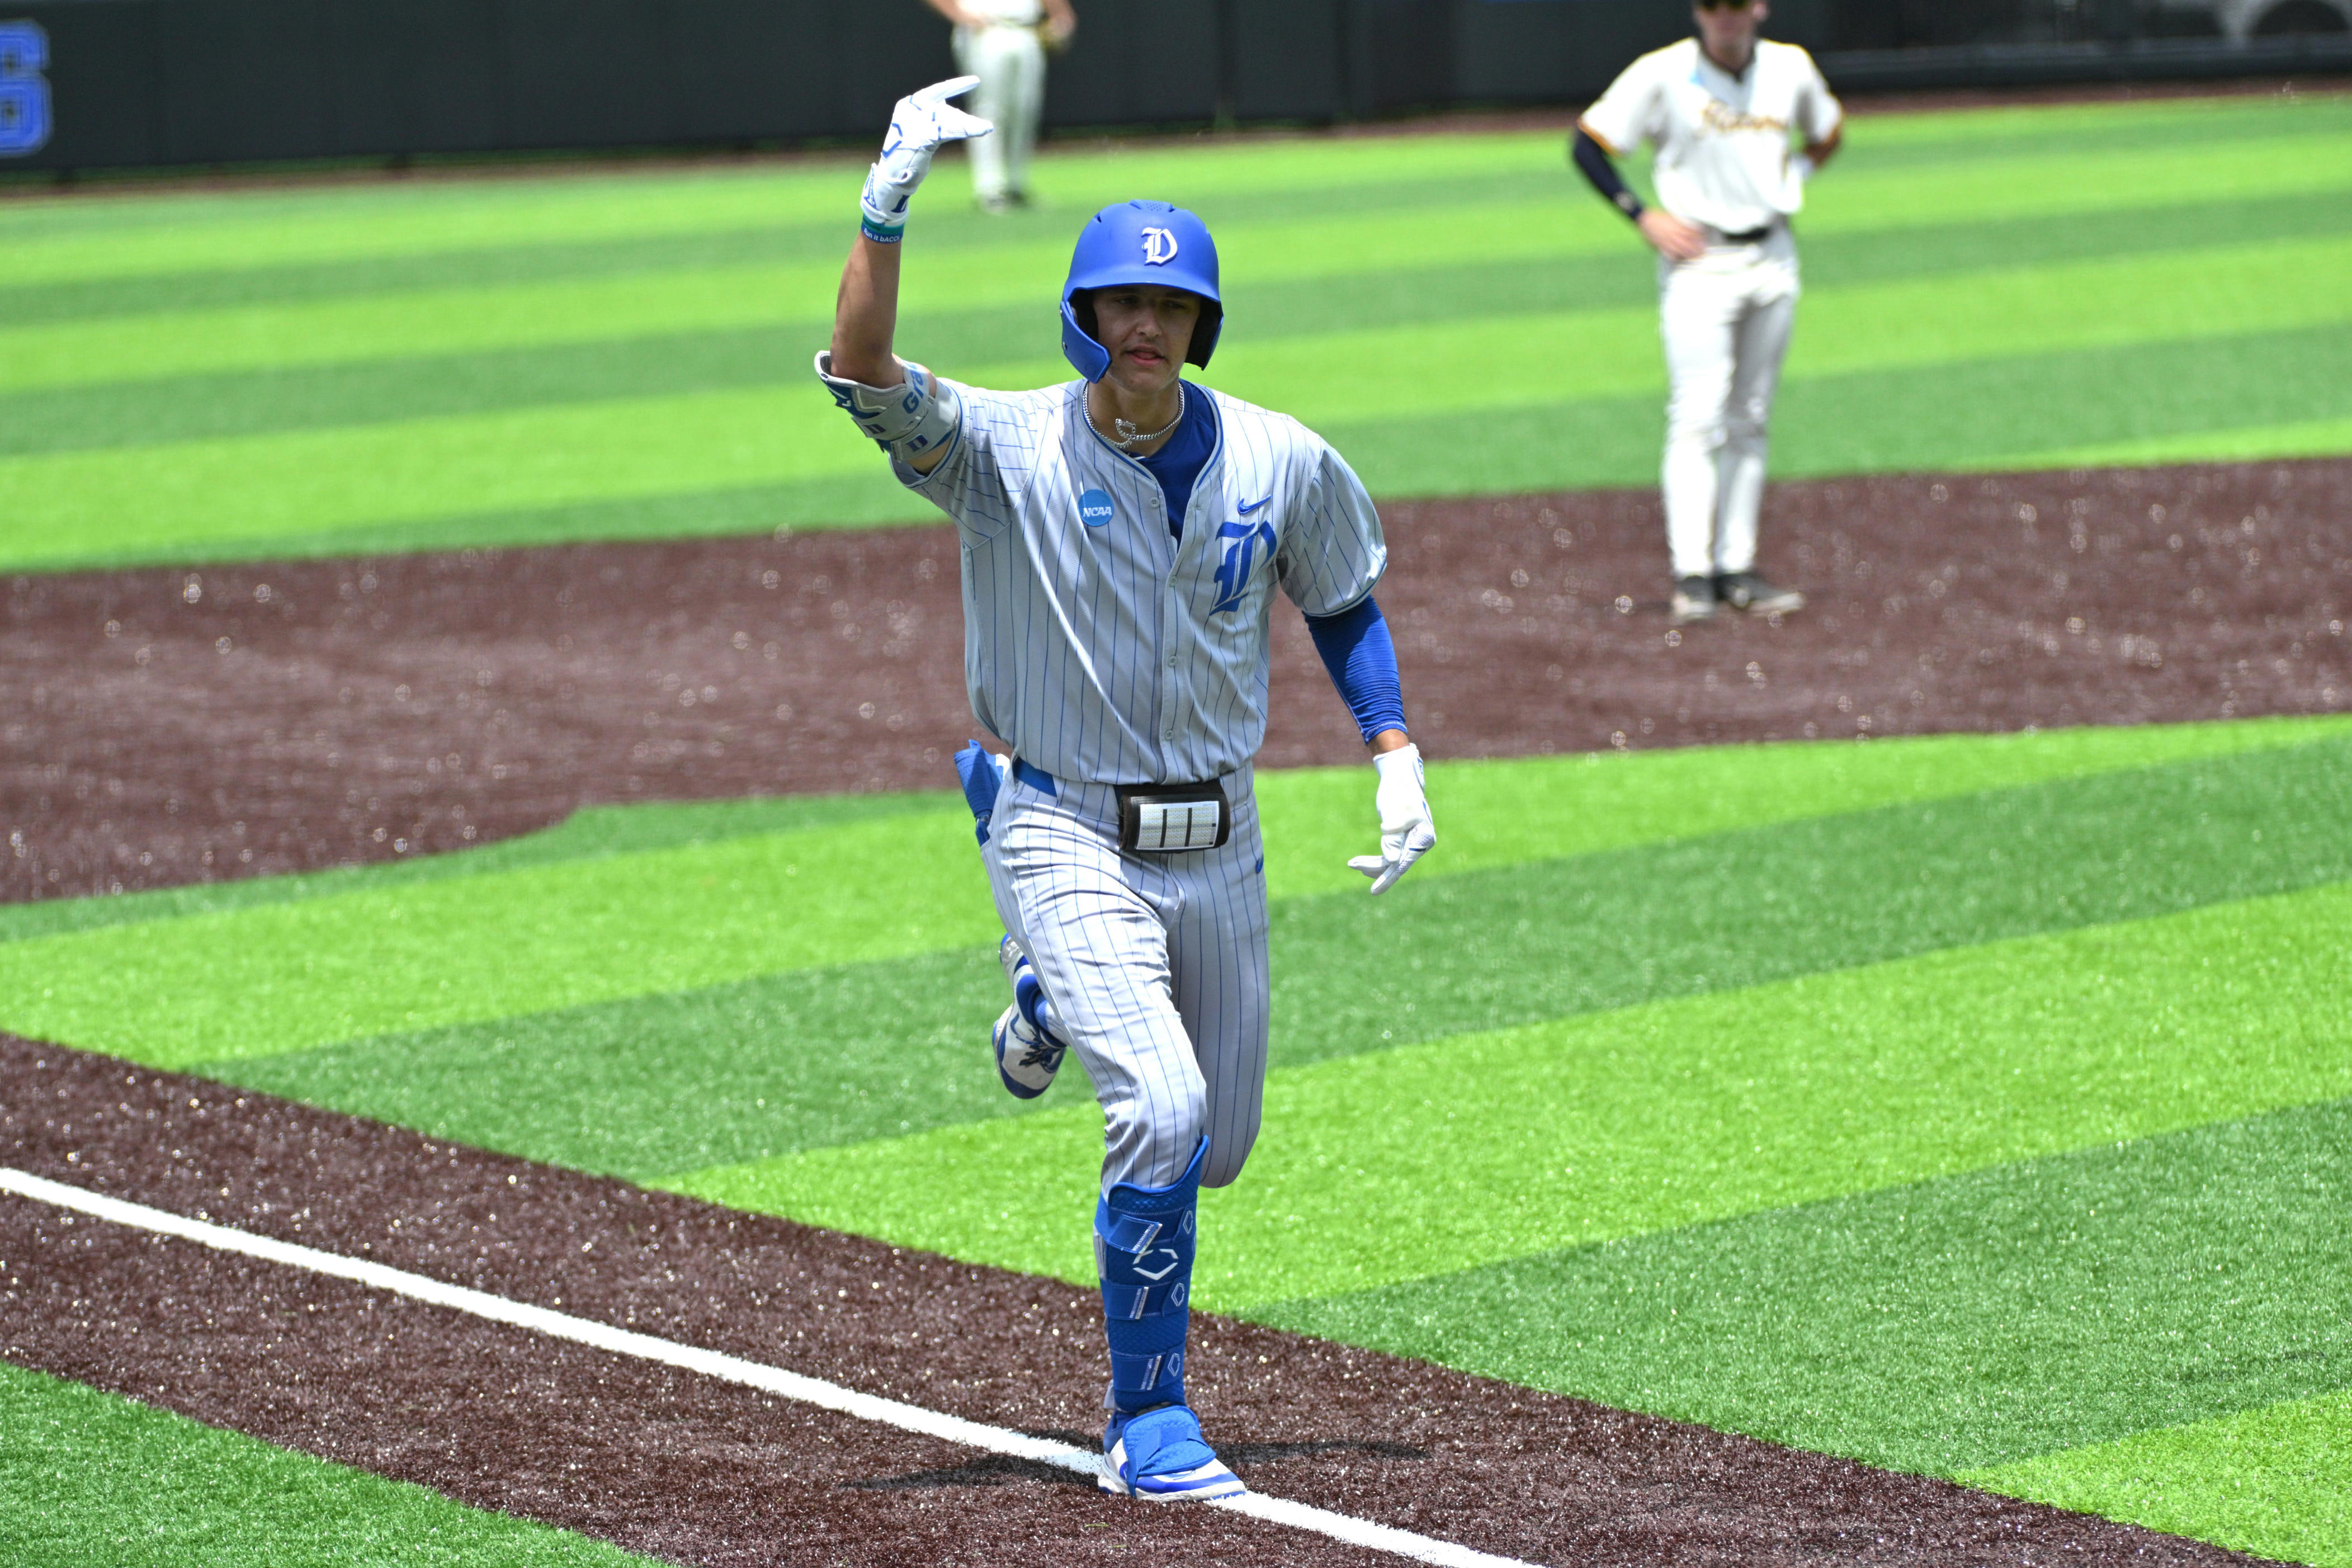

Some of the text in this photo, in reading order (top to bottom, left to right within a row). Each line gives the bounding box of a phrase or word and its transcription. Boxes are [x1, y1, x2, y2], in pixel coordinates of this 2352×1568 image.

[1141, 226, 1178, 264] D
[1083, 506, 1112, 517] NCAA
[1209, 519, 1277, 616] D
